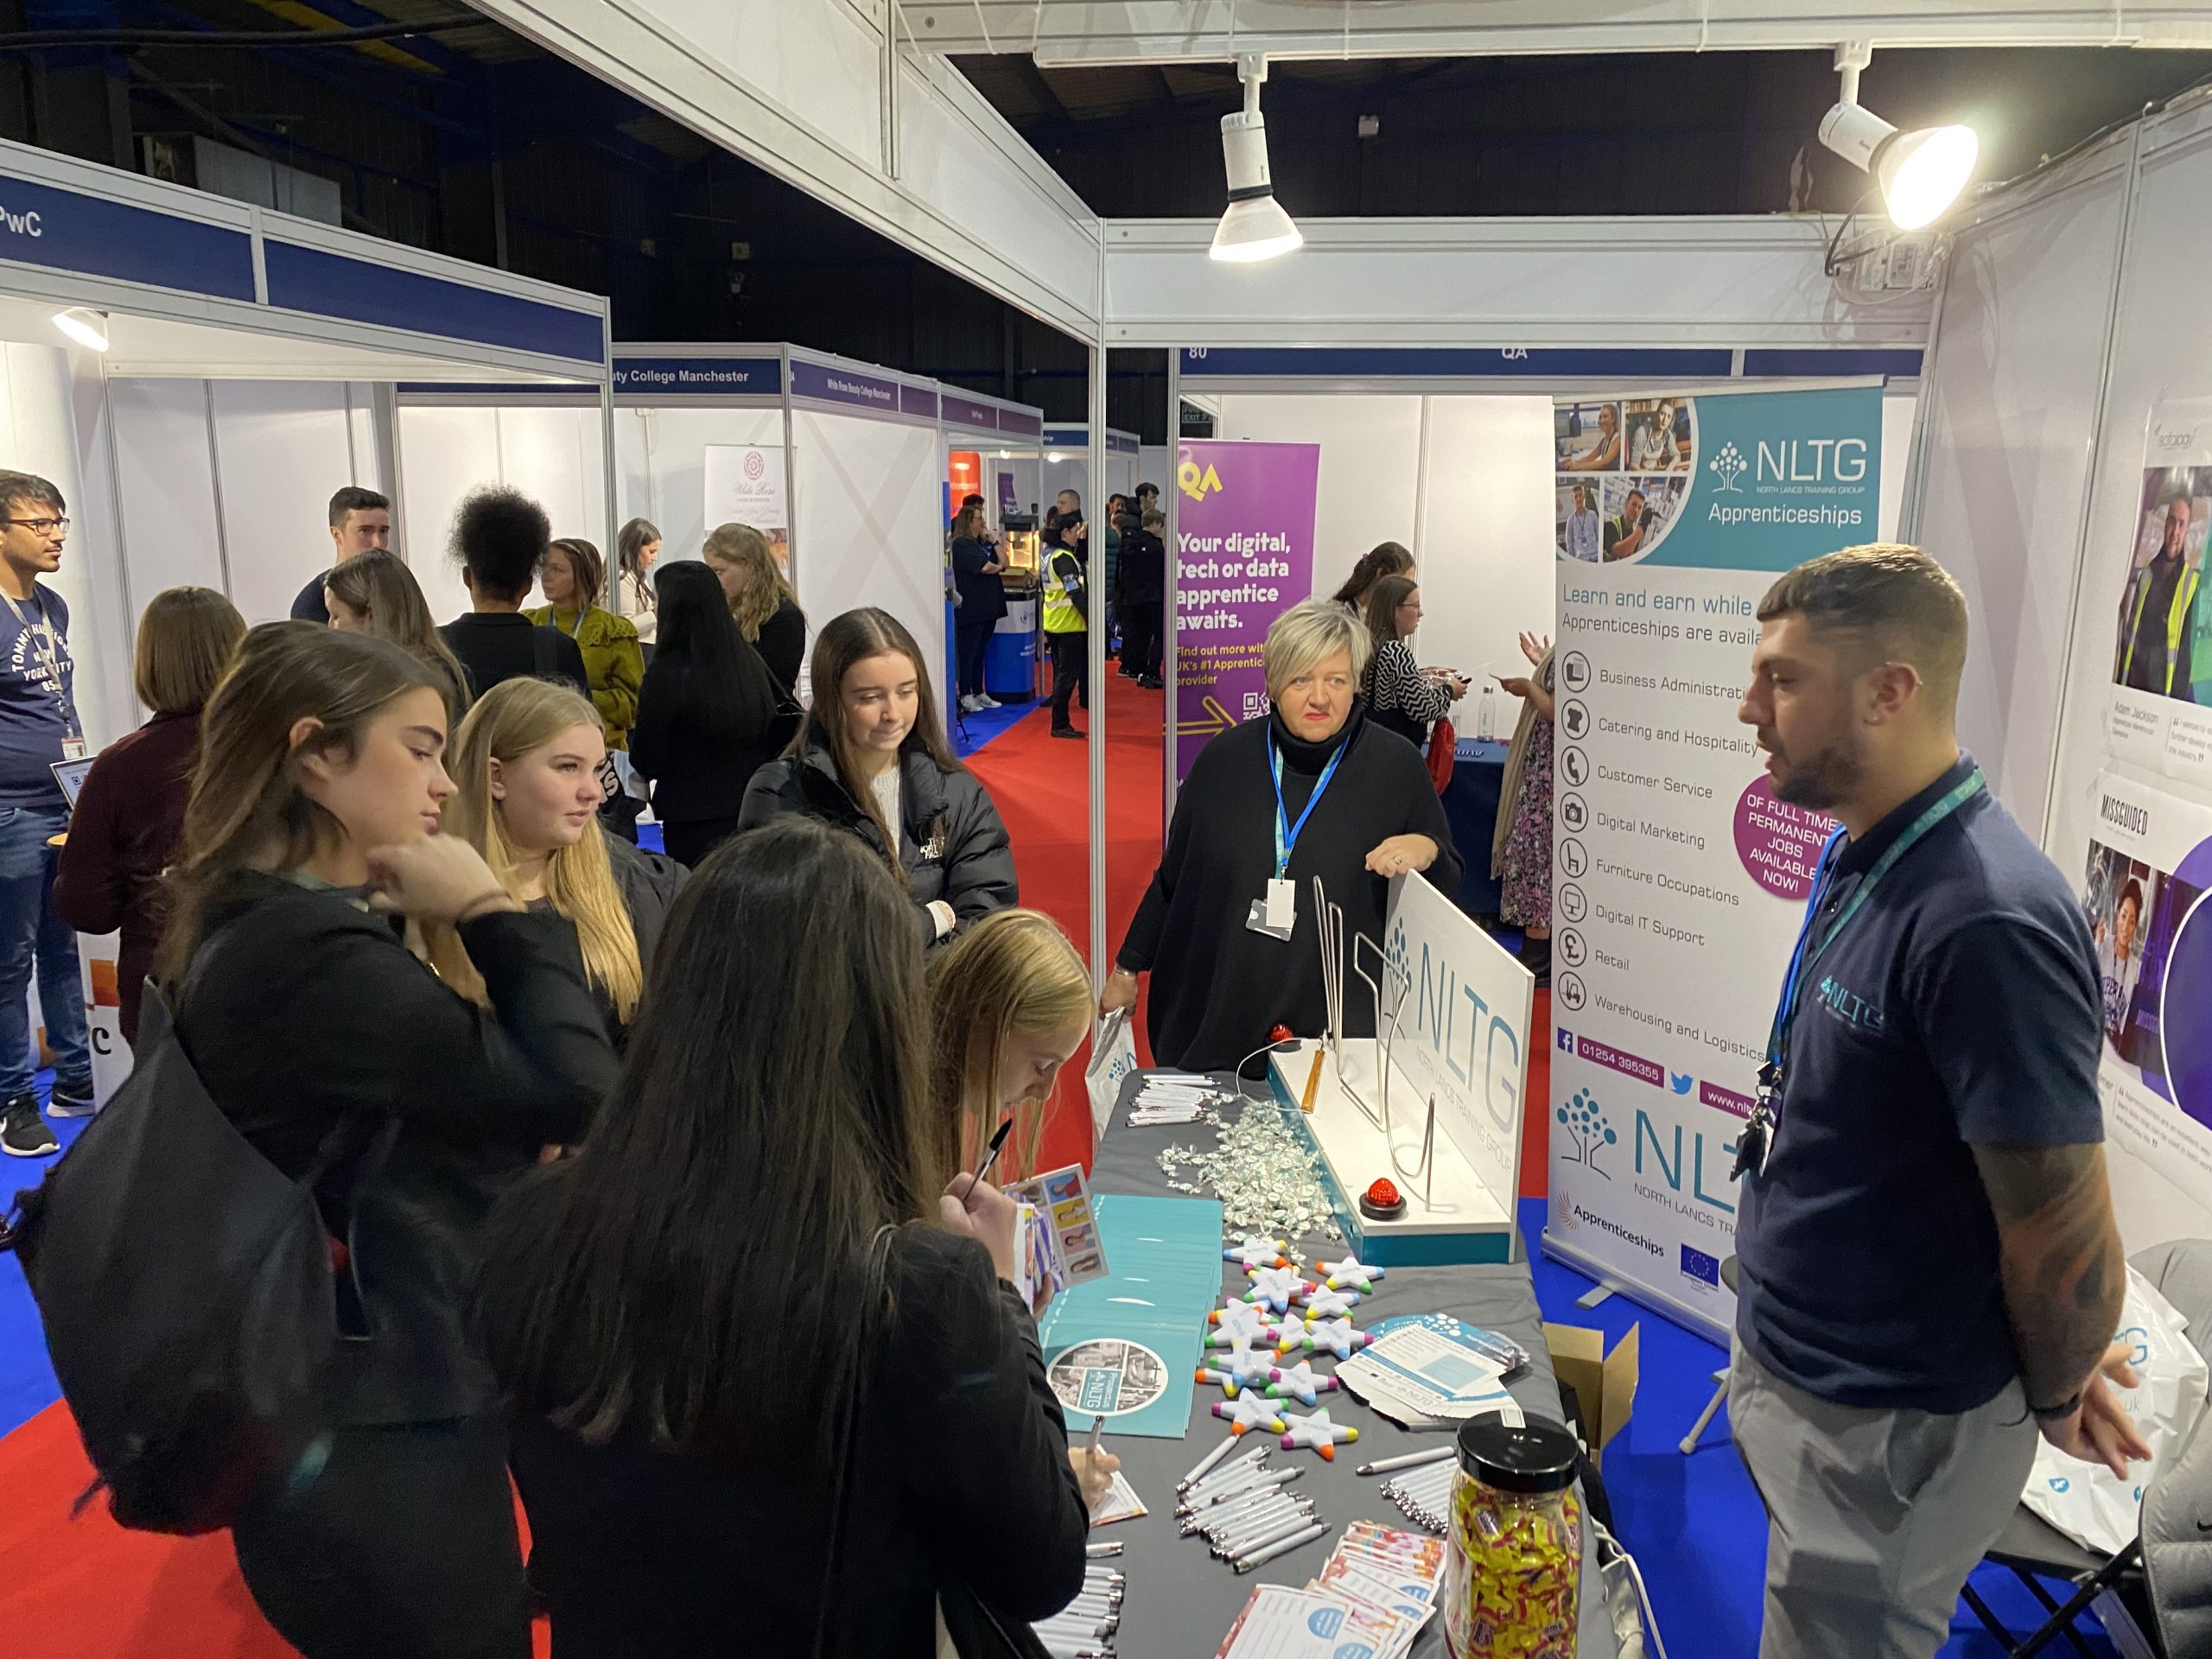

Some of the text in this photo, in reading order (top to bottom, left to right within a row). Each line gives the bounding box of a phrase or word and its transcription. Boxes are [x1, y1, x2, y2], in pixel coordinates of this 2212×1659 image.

[1189, 346, 1207, 359] 80
[1502, 347, 1528, 359] QA
[631, 370, 676, 384] College
[678, 370, 749, 382] Manchester
[1758, 439, 1866, 481] NLTG
[1178, 461, 1223, 501] QA
[1709, 503, 1862, 529] Apprenticeships
[1178, 532, 1291, 558] Your digital,
[1177, 558, 1289, 579] tech or data
[1177, 583, 1279, 610] apprentice
[1563, 584, 1751, 617] Learn and earn while
[1177, 610, 1243, 630] awaits.
[1562, 613, 1680, 640] Apprenticeships
[1686, 626, 1713, 641] are
[12, 628, 31, 672] TOMMY
[1200, 645, 1217, 656] out
[1219, 645, 1245, 655] more
[1600, 669, 1656, 690] Business
[1599, 717, 1758, 757] Catering and Hospitality
[1598, 766, 1713, 799] Customer Service
[1747, 794, 1839, 832] OF FULL TIME
[2101, 794, 2149, 836] MISSGUIDED
[1597, 812, 1706, 850] Digital Marketing
[1767, 836, 1803, 858] JOBS
[1597, 859, 1739, 906] Furniture Occupations
[1763, 869, 1799, 893] NOW!
[1596, 905, 1706, 946] Digital IT Support
[1595, 950, 1630, 971] Retail
[1827, 982, 1885, 1029] NLTG
[1418, 942, 1519, 1135] NLTG
[1595, 994, 1766, 1063] Warehousing and Logistics
[1581, 1042, 1659, 1081] 01254 395355
[1416, 1045, 1512, 1172] NORTH LANCS TRAINING GROUP
[1634, 1182, 1672, 1210] NORTH
[1675, 1201, 1715, 1229] LANCS
[1574, 1205, 1664, 1258] Apprenticeships
[1087, 1382, 1104, 1408] NLTG
